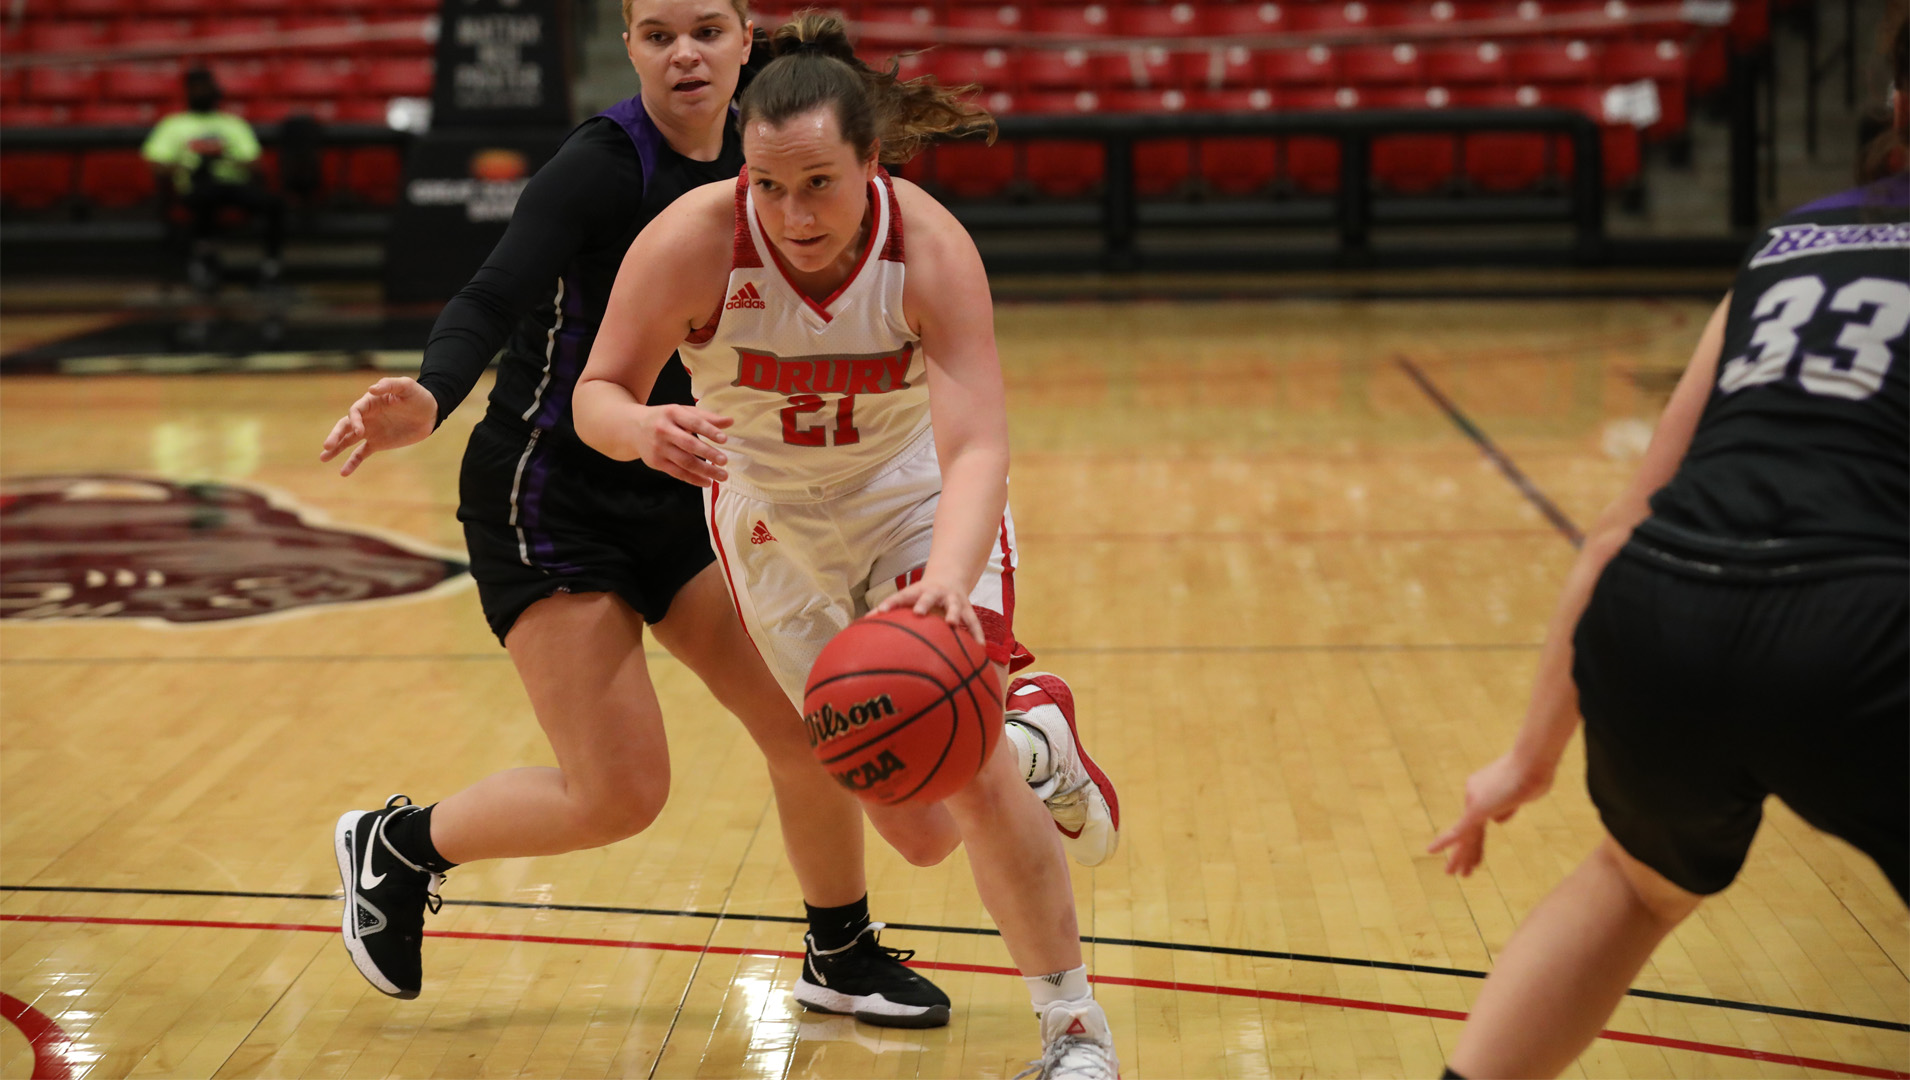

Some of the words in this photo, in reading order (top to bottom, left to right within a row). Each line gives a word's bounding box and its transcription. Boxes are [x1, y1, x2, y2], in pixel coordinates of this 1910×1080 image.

[725, 298, 766, 310] adidas
[1718, 274, 1910, 401] 33
[731, 341, 915, 396] DRURY
[780, 394, 860, 447] 21
